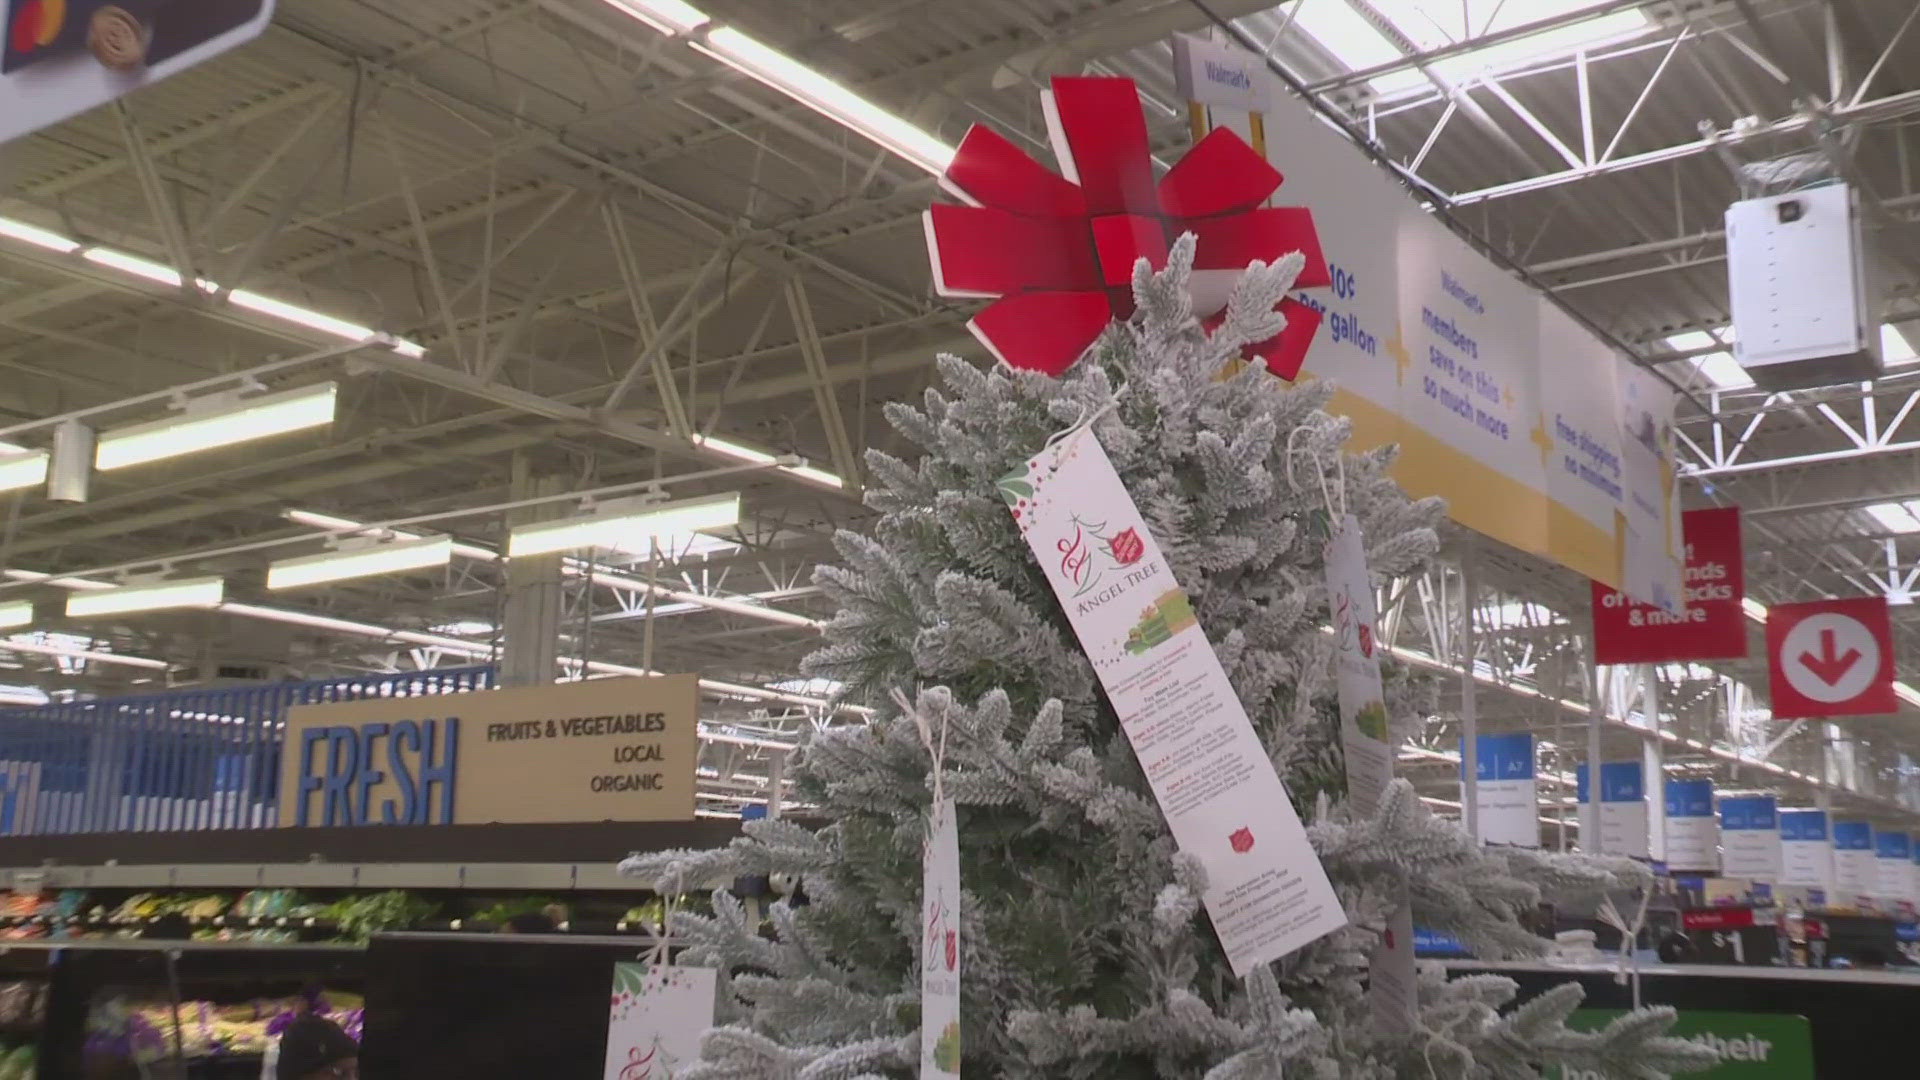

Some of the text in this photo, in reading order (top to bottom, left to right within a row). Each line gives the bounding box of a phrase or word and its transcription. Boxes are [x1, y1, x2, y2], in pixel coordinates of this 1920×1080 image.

[1330, 264, 1355, 299] 10¢
[1330, 311, 1376, 356] gallon
[1422, 306, 1477, 359] members
[1429, 344, 1499, 403] save on this
[1424, 375, 1509, 440] so much more
[1077, 562, 1160, 616] ANGEL TREE
[1629, 609, 1645, 626] &
[487, 712, 665, 743] FRUITS & VEGETABLES
[295, 716, 459, 827] FRESH
[614, 745, 663, 764] LOCAL
[590, 774, 663, 793] ORGANIC
[1712, 930, 1745, 964] $1
